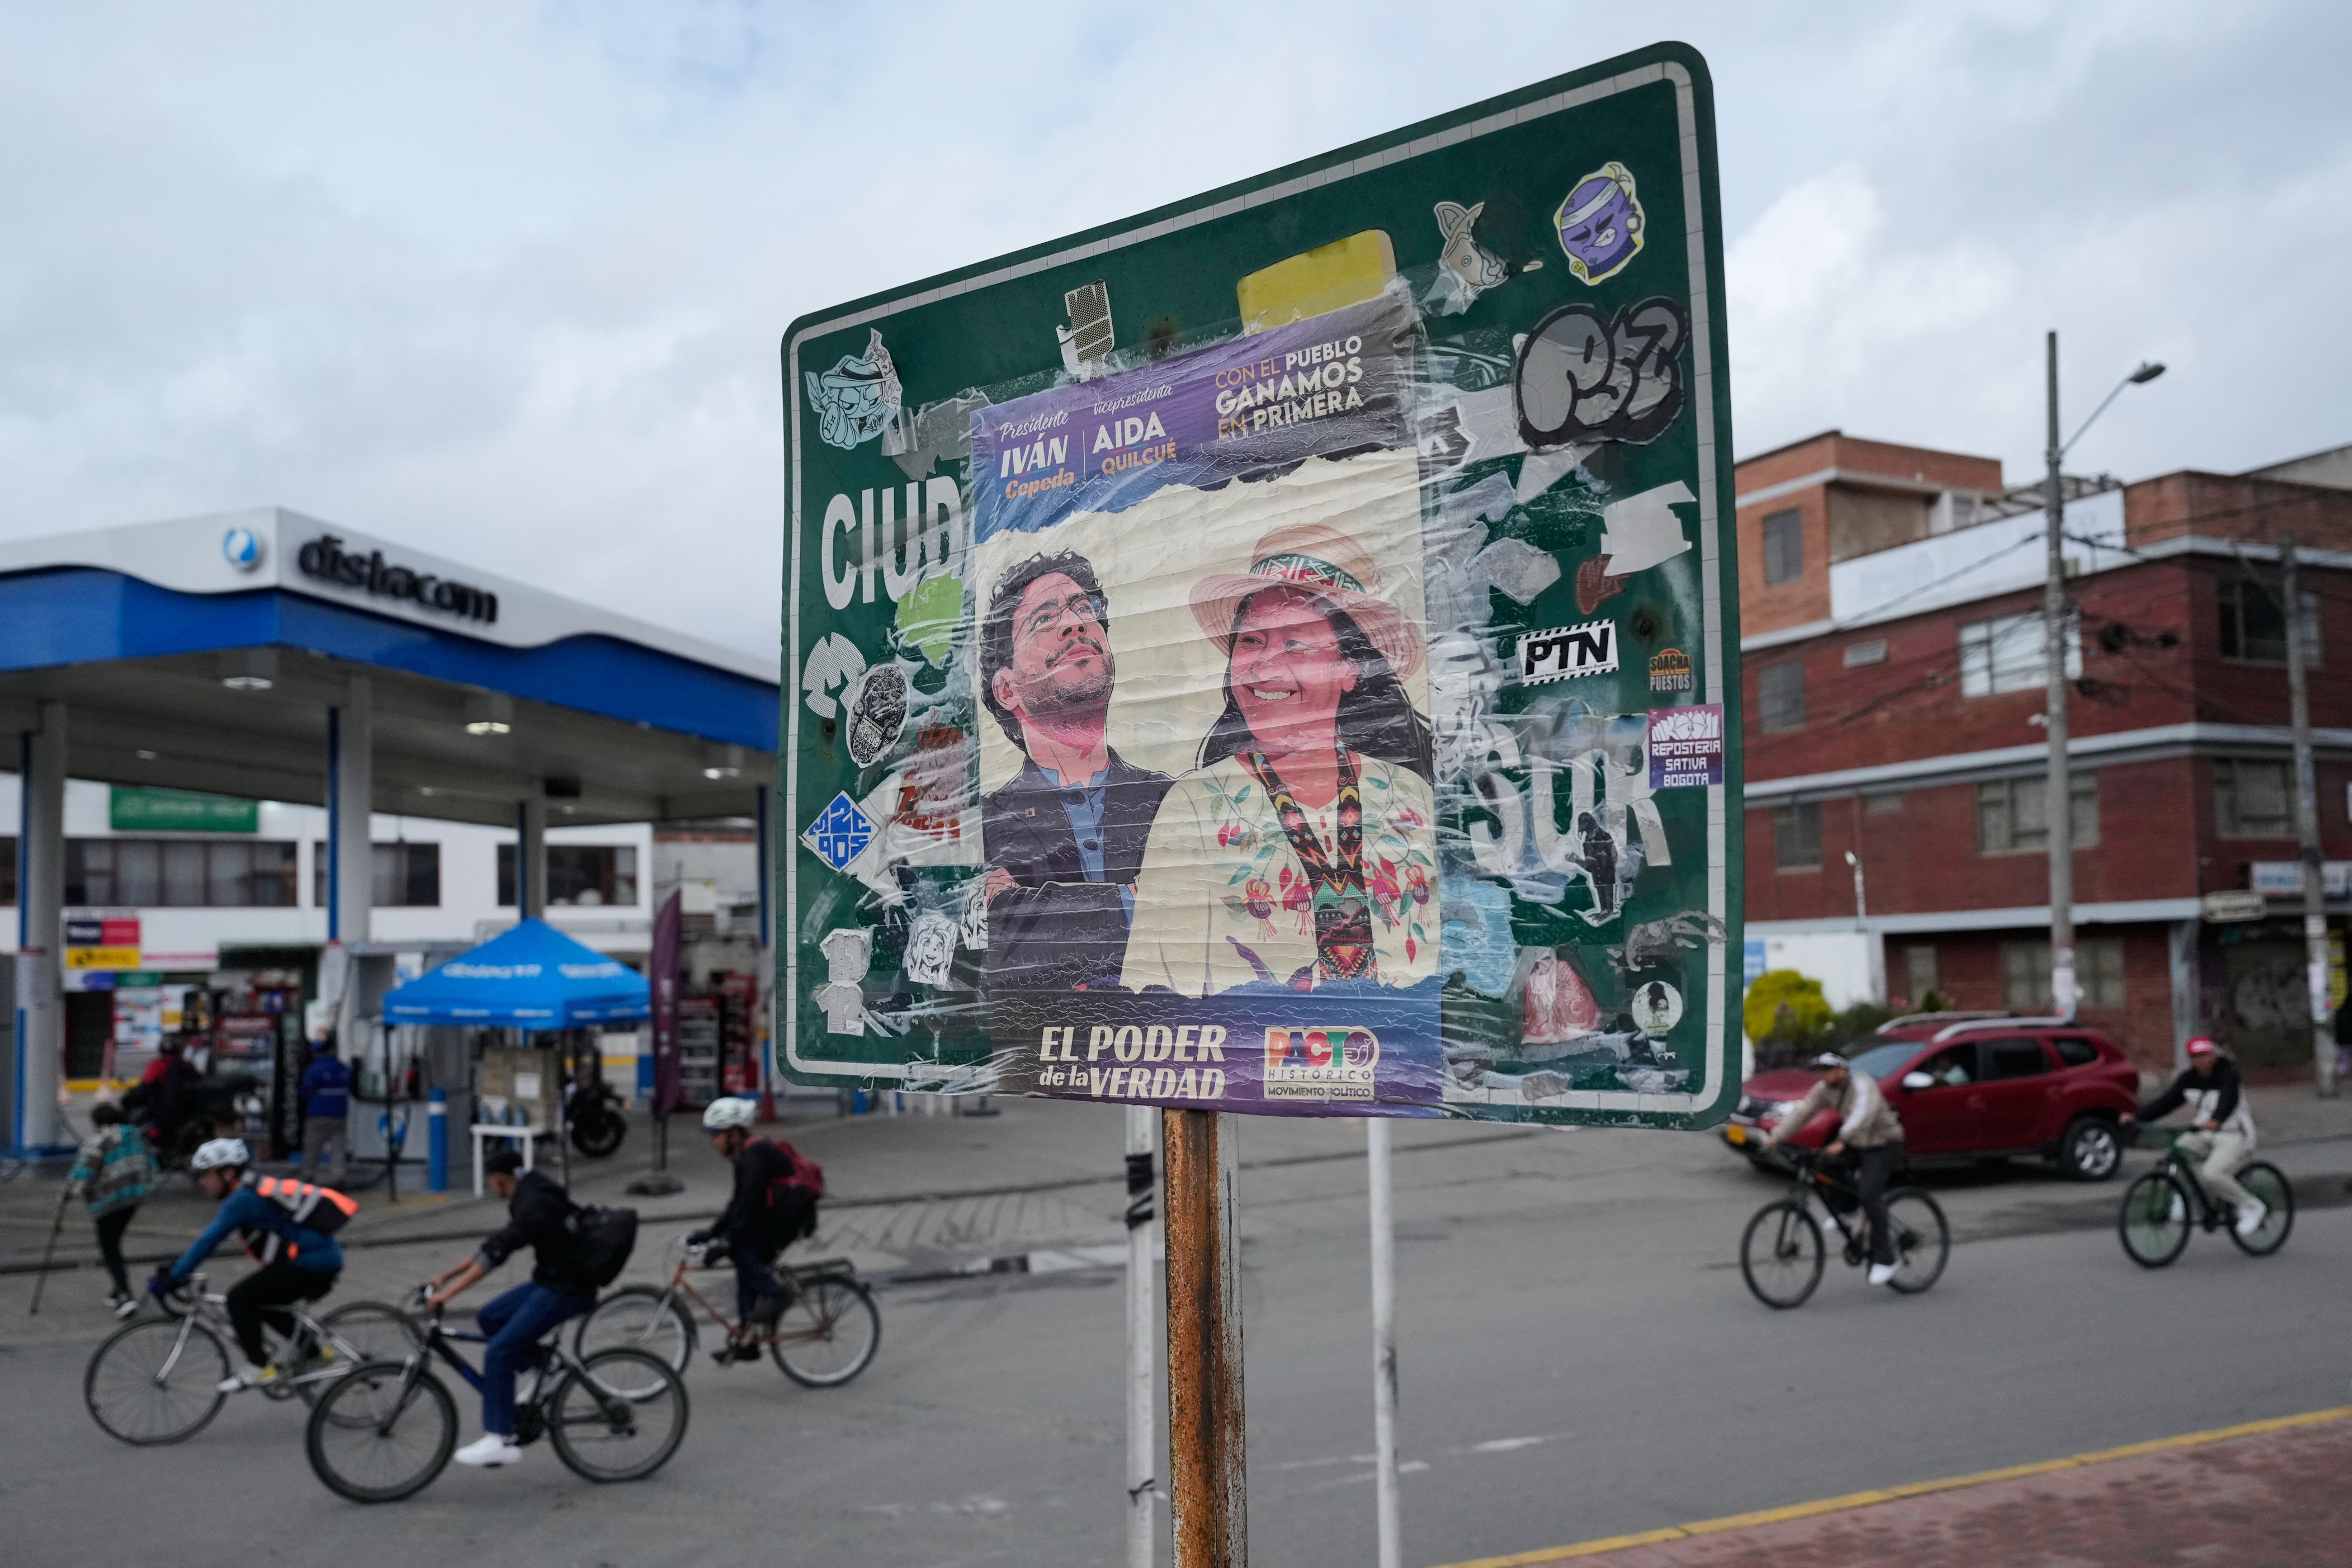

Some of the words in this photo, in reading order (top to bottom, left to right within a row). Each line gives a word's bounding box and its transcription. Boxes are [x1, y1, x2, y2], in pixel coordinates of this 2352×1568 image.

[1216, 364, 1255, 388] CON
[1260, 358, 1281, 377] EL
[1286, 336, 1362, 370] PUEBLO
[1093, 384, 1173, 415] Vicepresidenta
[1216, 356, 1363, 414] GANAMOS
[1000, 409, 1069, 442] Presidente
[1218, 413, 1246, 438] EN
[1253, 386, 1364, 431] PRIMERA
[1092, 412, 1166, 454] AIDA
[1000, 432, 1069, 478] IVÁN
[1102, 438, 1177, 475] QUILCUÉ
[1005, 468, 1075, 499] Cepeda
[1525, 627, 1609, 676] PTN
[1650, 654, 1689, 671] SOACHA
[1650, 674, 1690, 691] PUESTOS
[1652, 740, 1721, 756] REPOSTERIA
[1665, 757, 1707, 771] SATIVA
[1664, 773, 1709, 787] BOGOTA
[1039, 1026, 1079, 1061] EL
[1088, 1025, 1226, 1062] PODER
[1269, 1031, 1375, 1068] PACTO
[1039, 1065, 1065, 1086] de
[1069, 1065, 1089, 1087] la
[1090, 1068, 1226, 1100] VERDAD
[1268, 1067, 1371, 1080] HISTÓRICO
[1268, 1086, 1325, 1097] MOVIMIENTO
